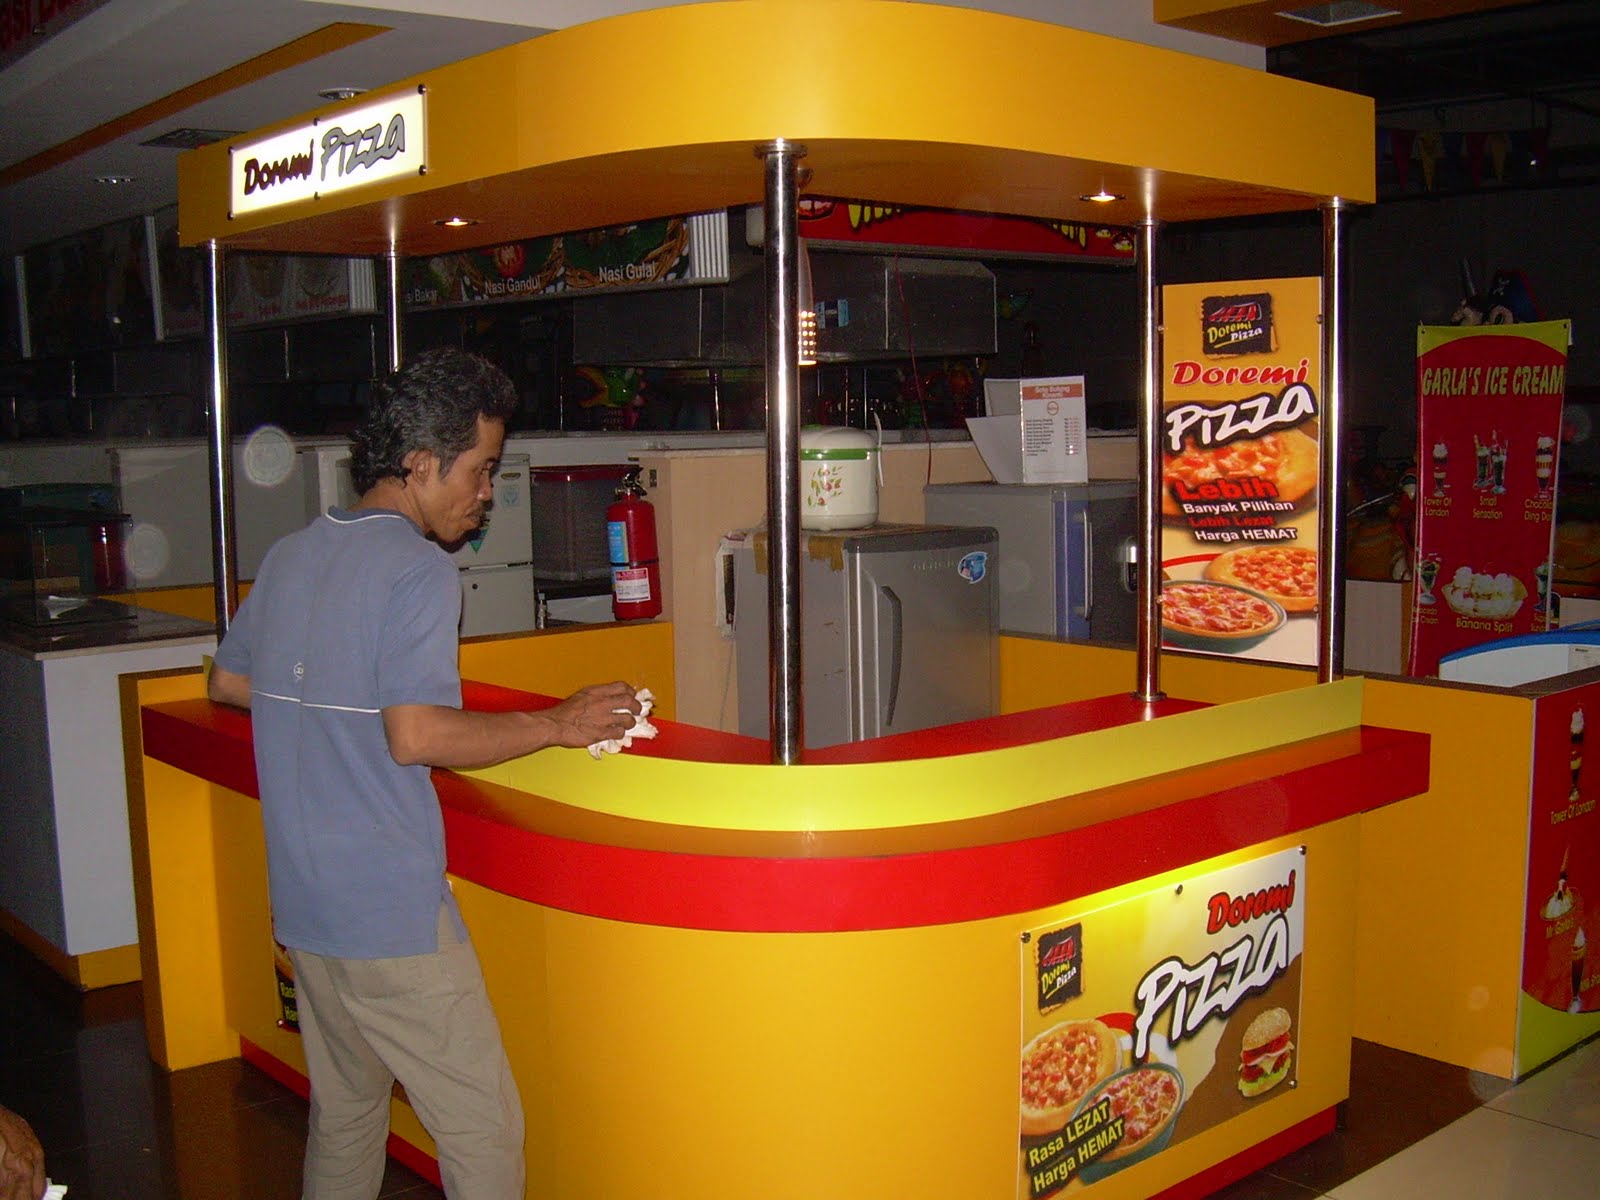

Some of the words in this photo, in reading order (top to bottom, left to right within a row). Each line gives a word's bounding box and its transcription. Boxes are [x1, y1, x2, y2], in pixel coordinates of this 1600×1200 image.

[484, 279, 506, 295] Nasi
[506, 275, 542, 293] Gandul
[599, 265, 624, 282] Nasi
[1207, 321, 1252, 344] Doremi
[1230, 327, 1263, 342] Pizza
[1171, 358, 1311, 387] Doremi
[1423, 366, 1482, 397] GARLA'S
[1484, 366, 1510, 396] ICE
[1512, 364, 1565, 397] CREAM
[1174, 477, 1280, 500] Lebih
[1182, 502, 1239, 516] Banyak
[1240, 501, 1294, 512] Pilihan
[1188, 515, 1231, 528] Lebih
[1232, 515, 1276, 527] Lezat
[1195, 530, 1240, 543] Harga
[1242, 528, 1298, 540] HEMAT
[1455, 616, 1492, 631] Banana
[1493, 620, 1514, 634] Split
[1207, 869, 1296, 935] Doremi
[1041, 960, 1071, 994] Doremi
[1056, 966, 1077, 989] Pizza
[1029, 1136, 1064, 1167] Rasa
[1066, 1101, 1109, 1143] LEZAT
[1033, 1156, 1076, 1193] Harga
[1077, 1118, 1123, 1164] HEMAT
